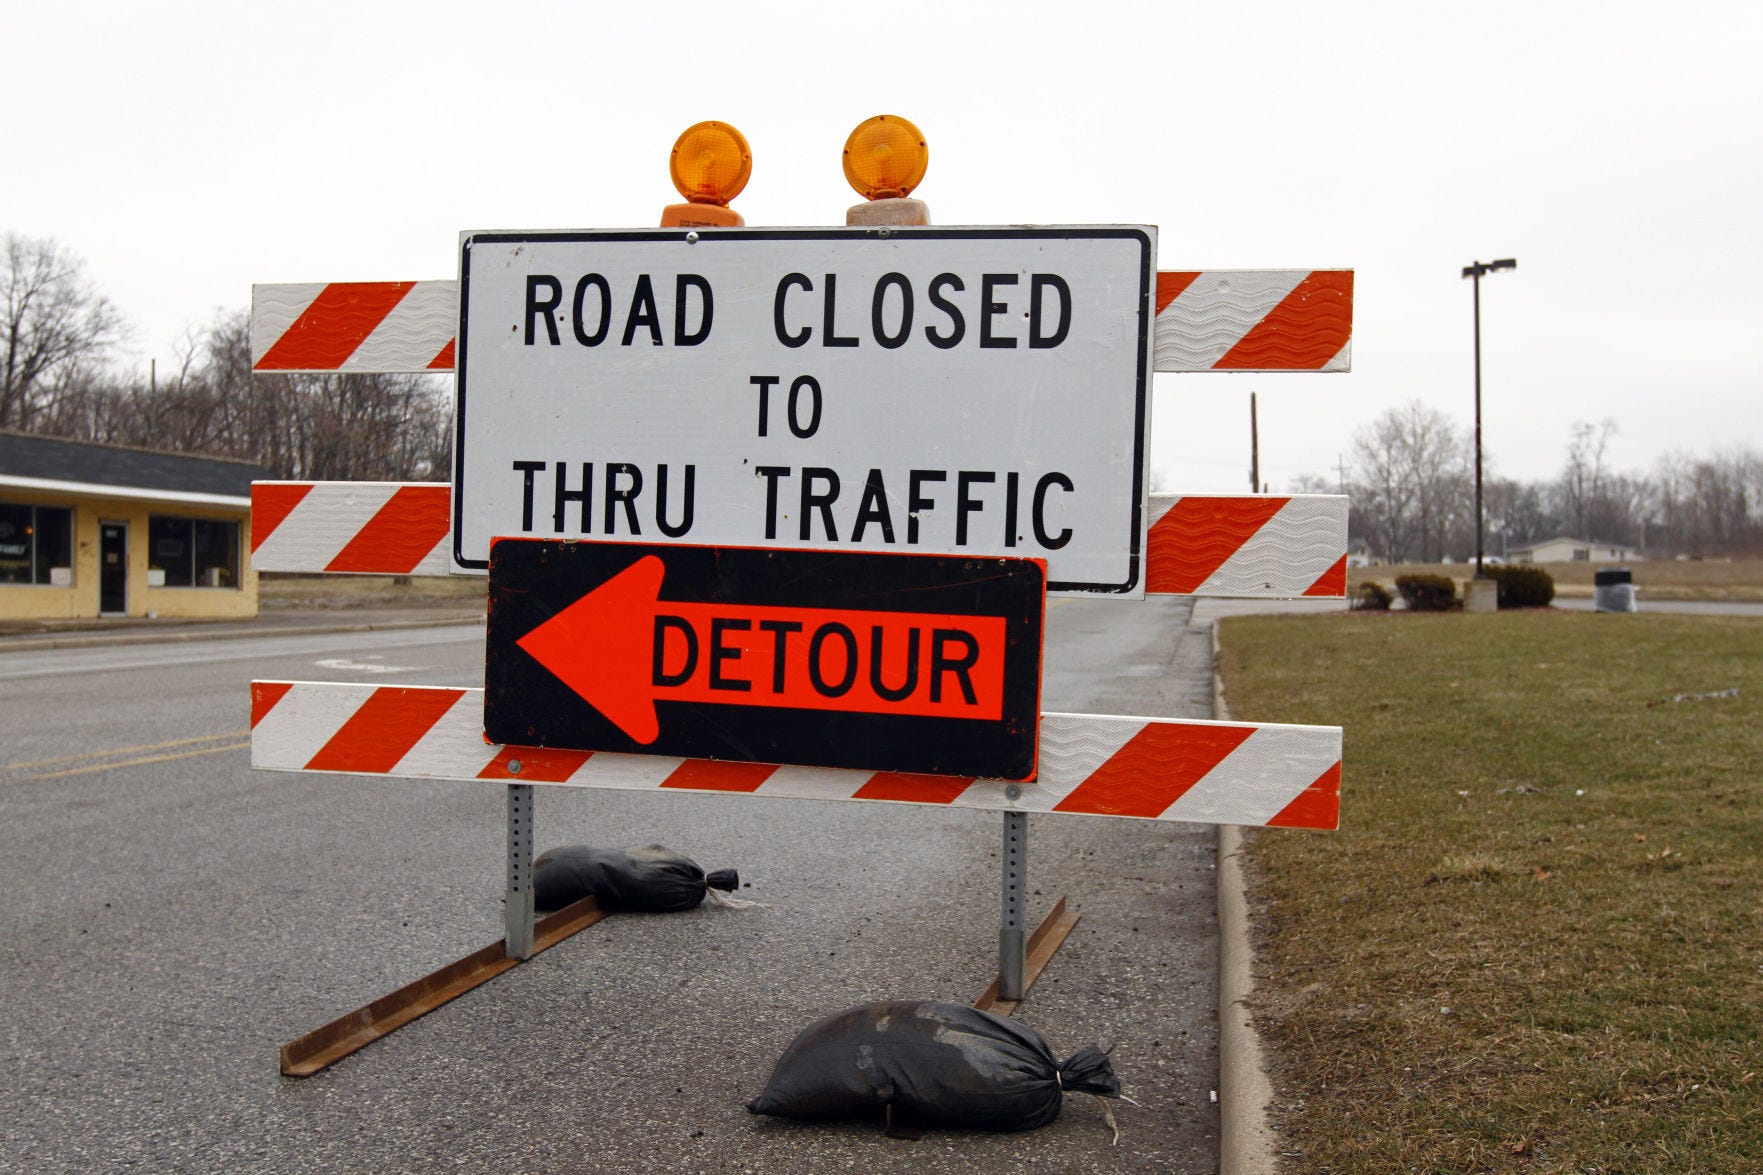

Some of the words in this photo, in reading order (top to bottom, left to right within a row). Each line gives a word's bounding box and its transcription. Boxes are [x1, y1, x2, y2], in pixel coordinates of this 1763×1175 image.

[525, 273, 713, 347] ROAD
[774, 272, 1071, 349] CLOSED
[750, 375, 822, 438] TO
[513, 461, 695, 538] THRU
[755, 466, 1074, 550] TRAFFIC
[652, 615, 980, 705] DETOUR
